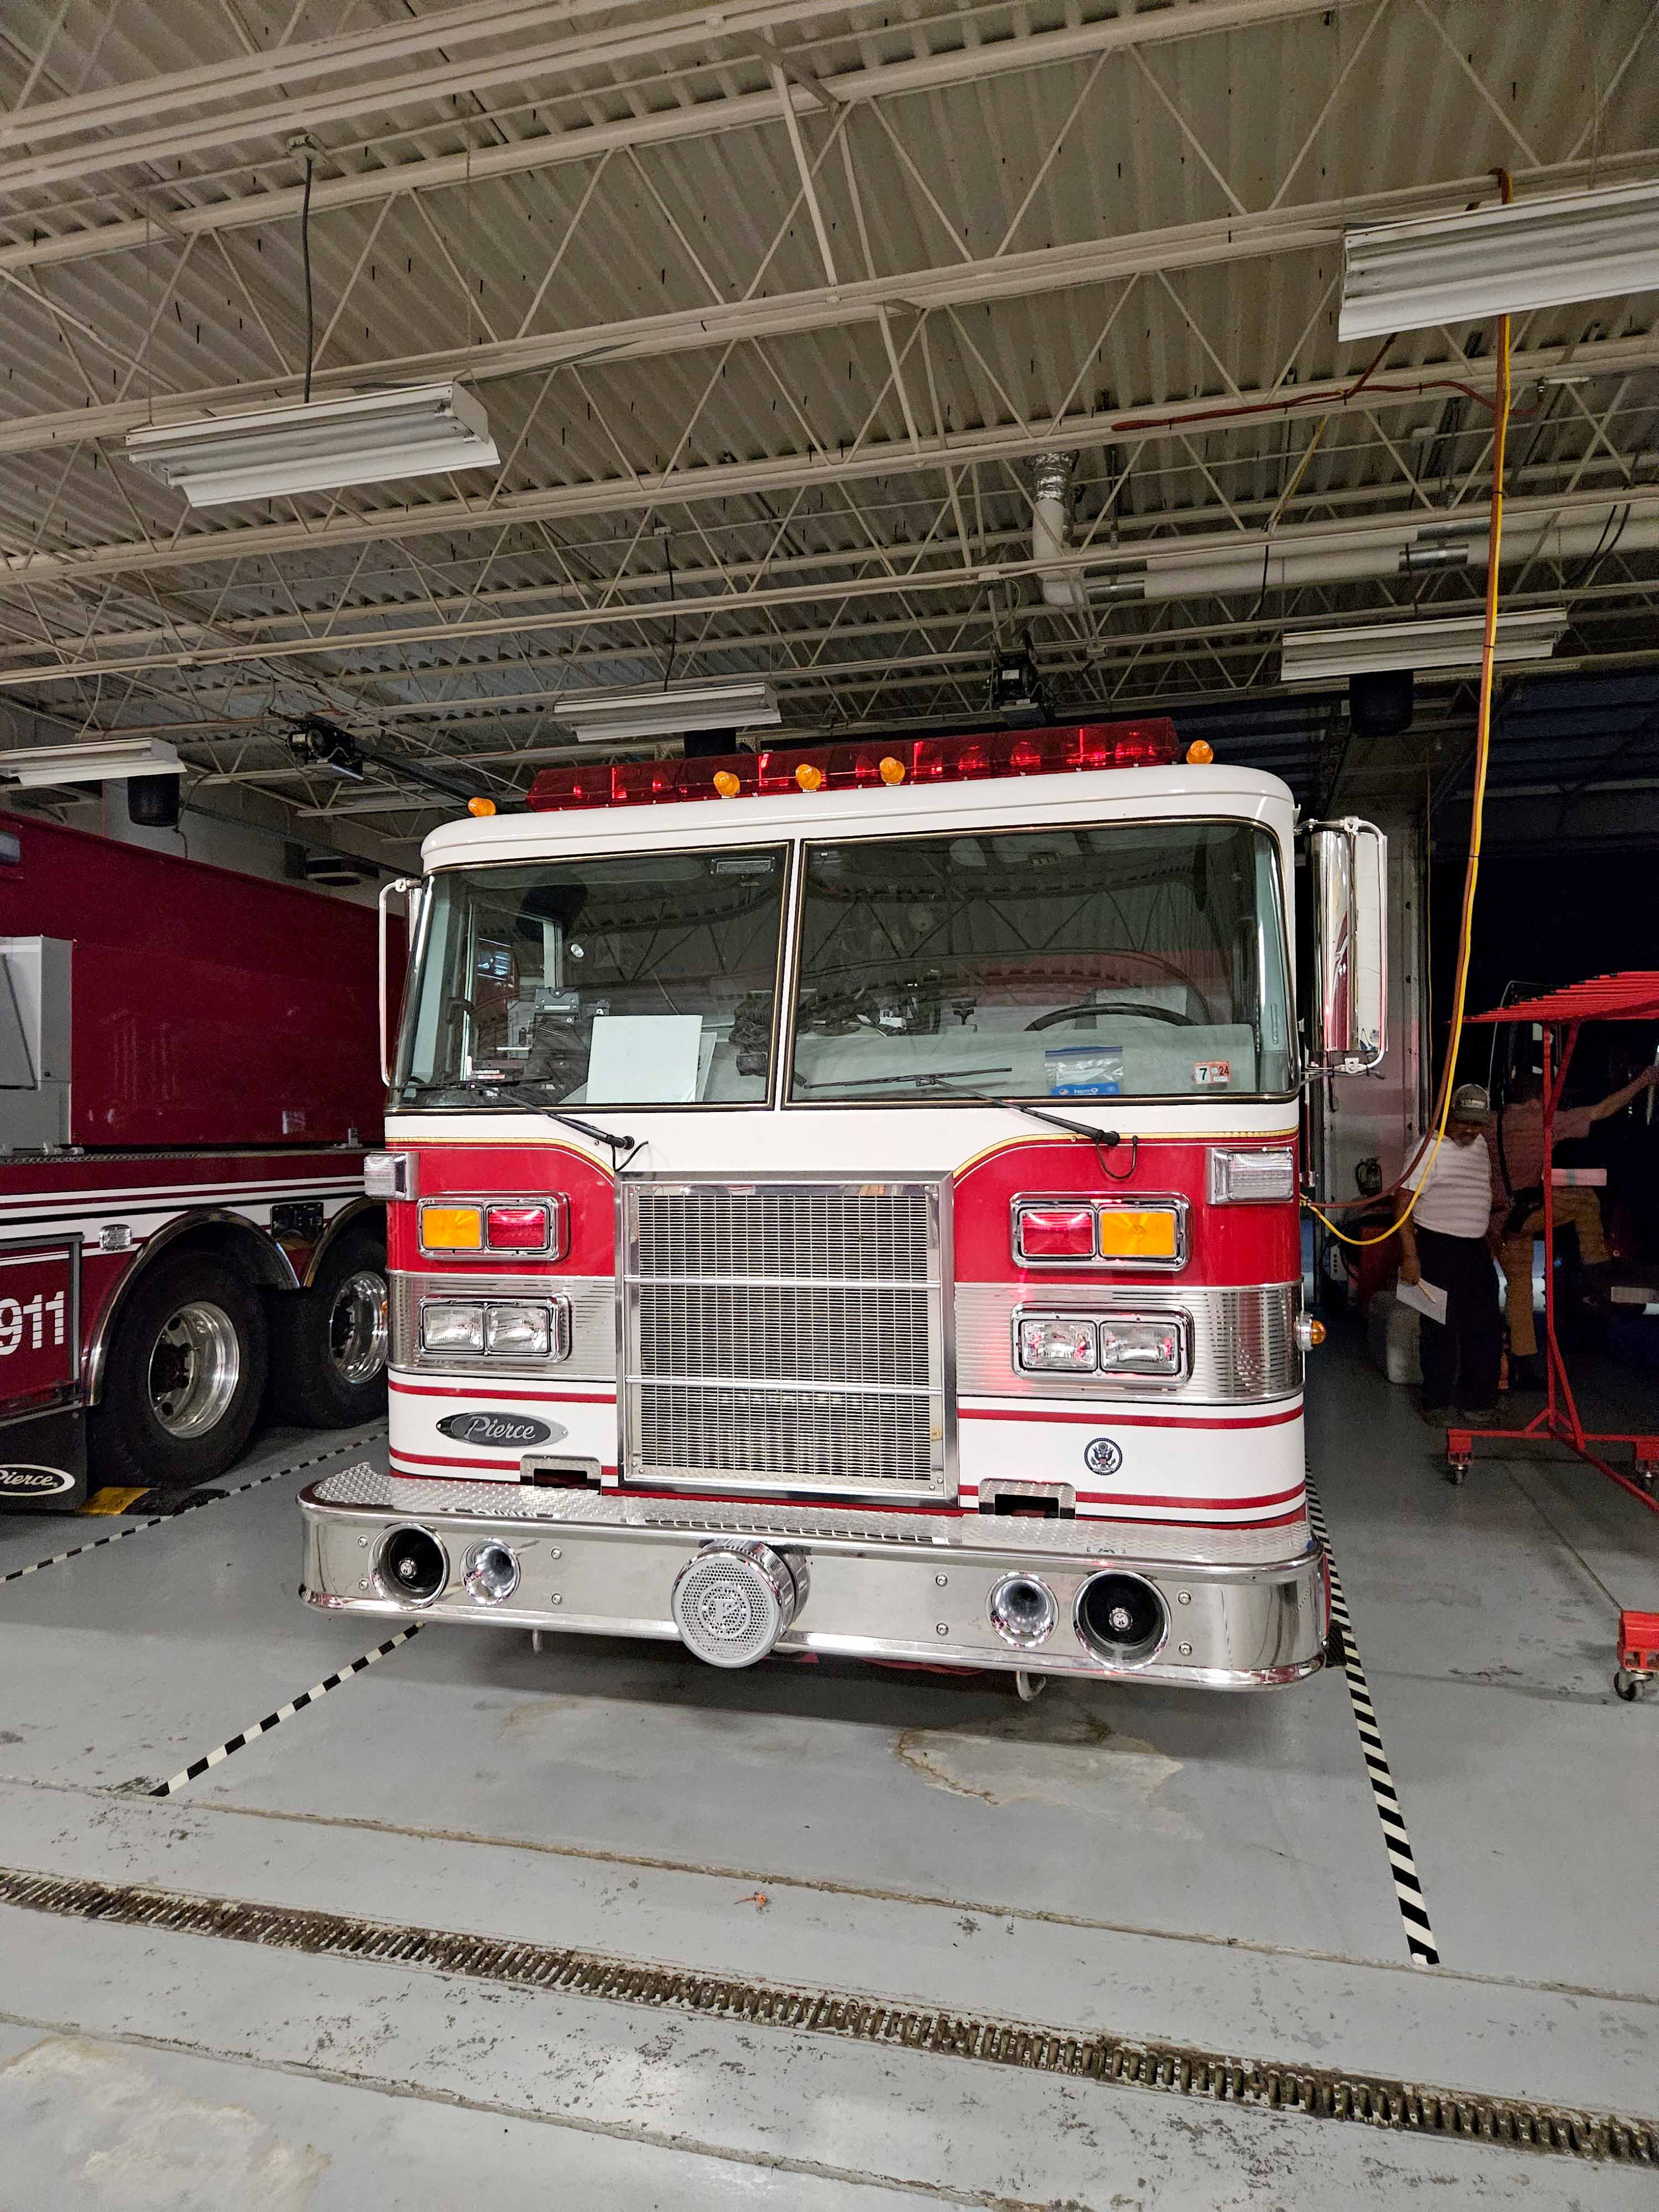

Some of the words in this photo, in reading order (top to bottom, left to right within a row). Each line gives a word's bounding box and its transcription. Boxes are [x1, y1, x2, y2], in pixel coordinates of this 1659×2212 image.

[1199, 1068, 1207, 1080] 7
[1219, 1066, 1229, 1076] 24
[0, 1291, 64, 1355] 911
[463, 1416, 536, 1439] Pierce
